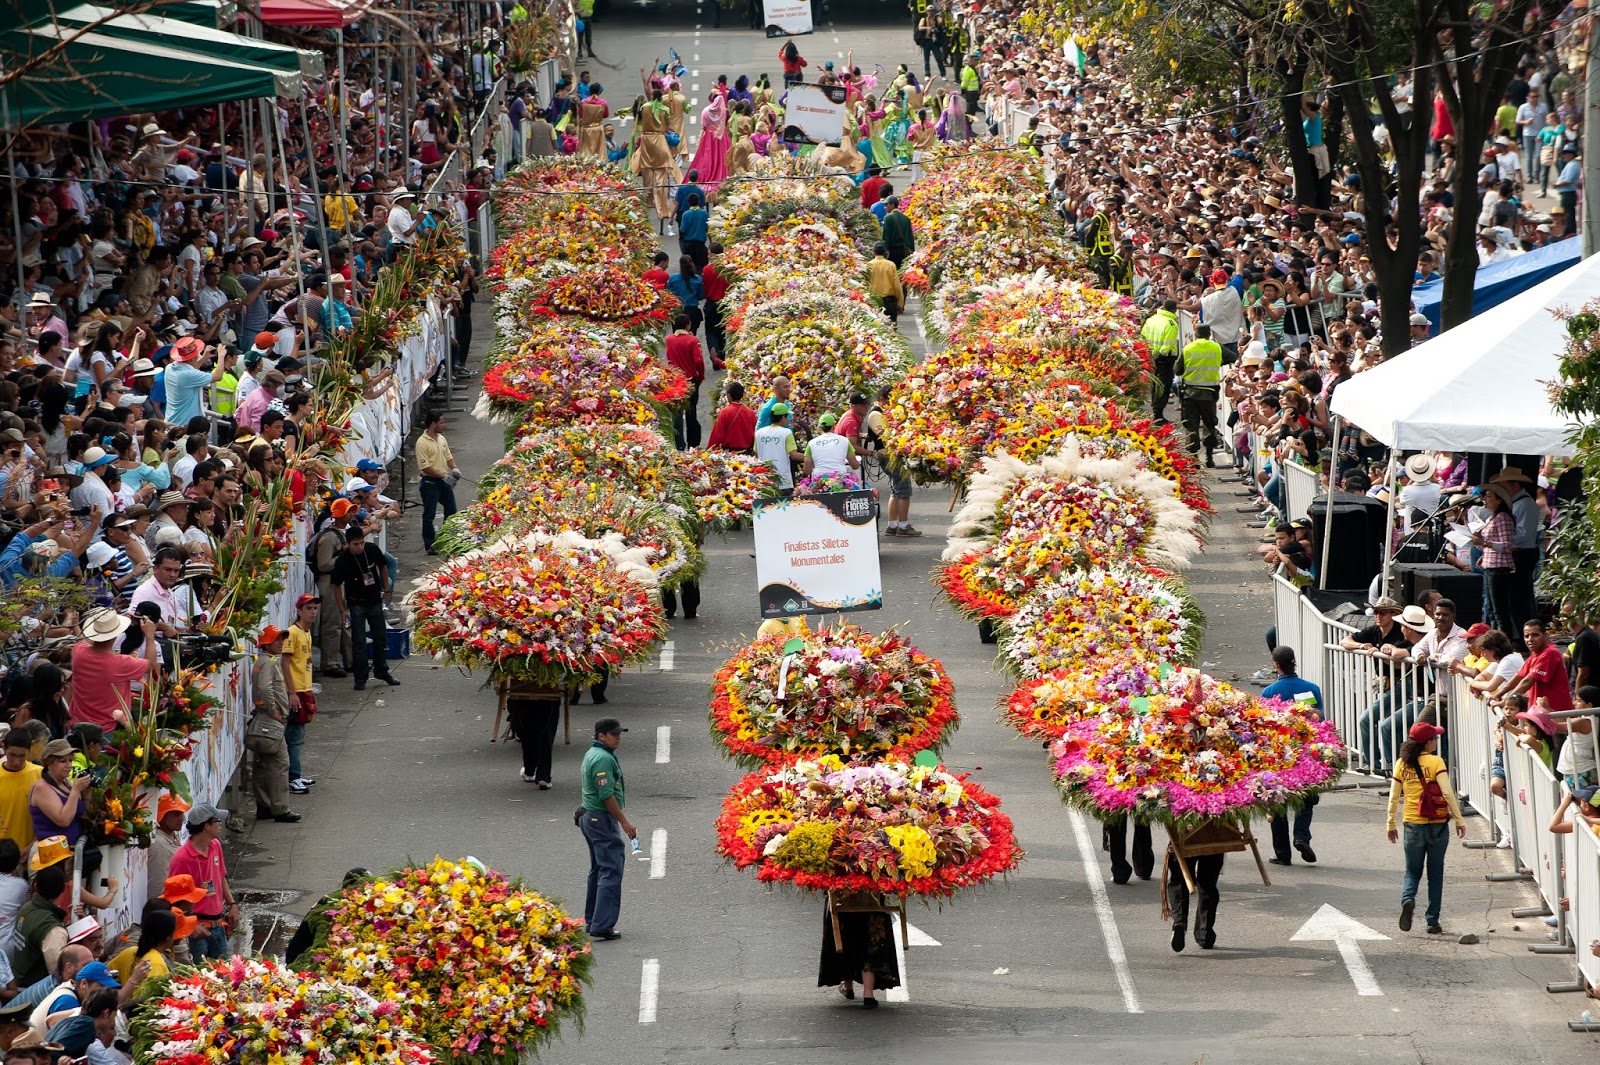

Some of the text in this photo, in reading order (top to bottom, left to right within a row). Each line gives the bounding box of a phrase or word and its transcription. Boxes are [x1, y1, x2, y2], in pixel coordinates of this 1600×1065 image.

[760, 436, 780, 444] epm
[816, 438, 839, 446] epm
[846, 500, 869, 511] Flores
[784, 538, 849, 553] Finalistas Silletas
[790, 553, 845, 568] Monumentales
